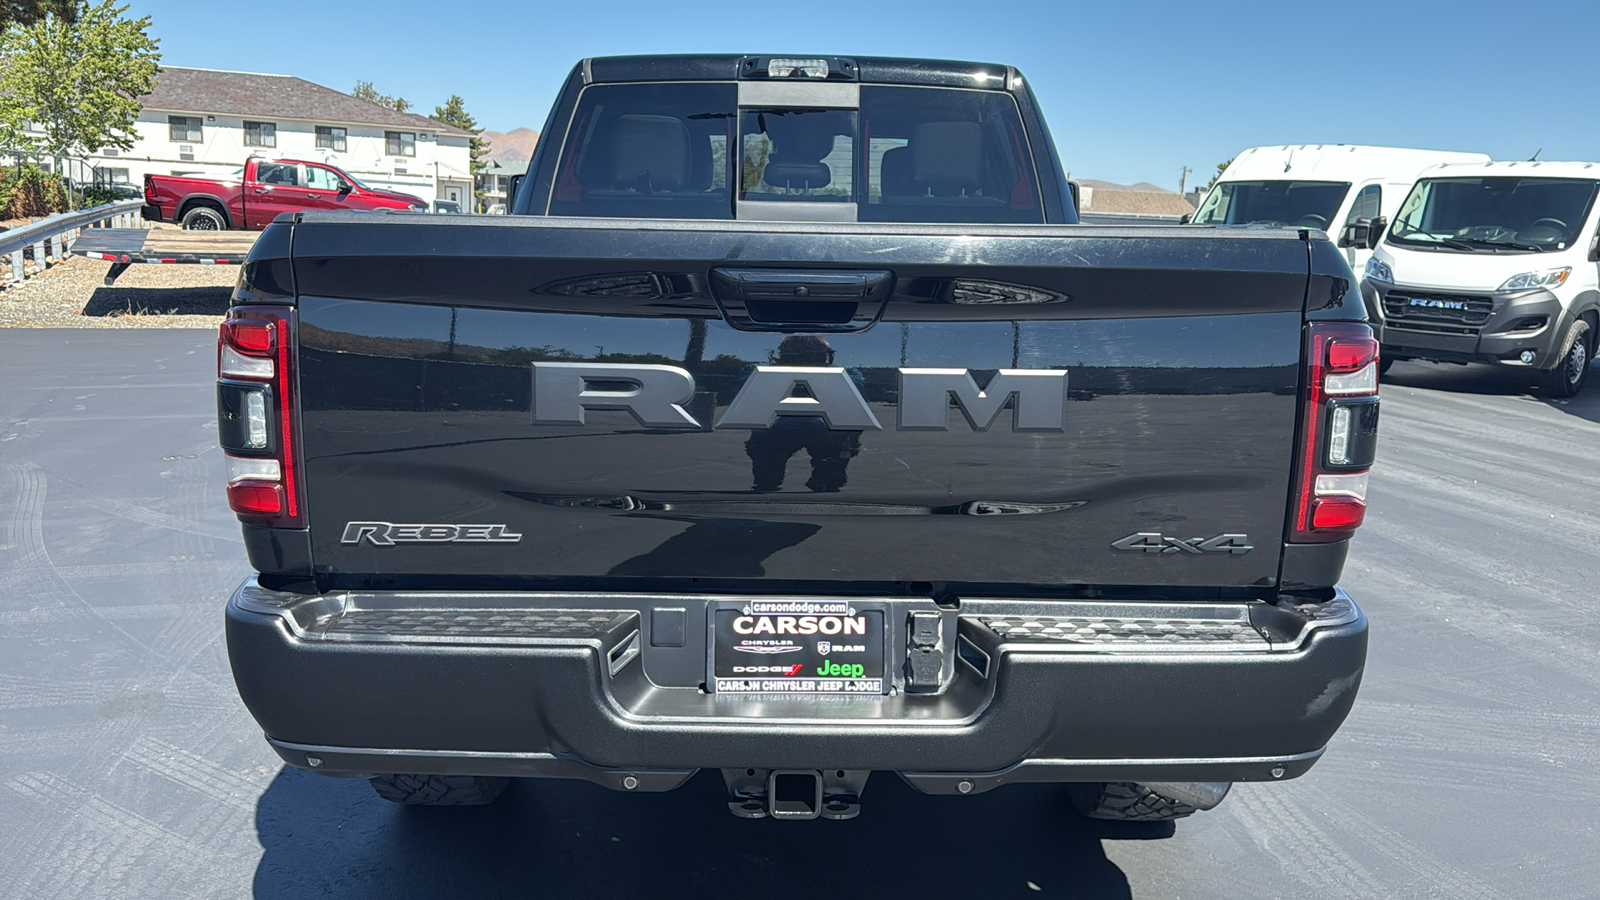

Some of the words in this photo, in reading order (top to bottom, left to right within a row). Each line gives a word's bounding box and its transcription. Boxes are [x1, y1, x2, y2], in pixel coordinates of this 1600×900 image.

[1410, 298, 1463, 310] RAM
[531, 361, 1069, 432] RAM
[340, 521, 523, 546] REBEL
[753, 602, 846, 614] carsondodge.com
[733, 616, 866, 635] CARSON
[816, 659, 865, 678] Jeep
[762, 680, 815, 691] CHRYSLER
[817, 680, 843, 691] JEEP
